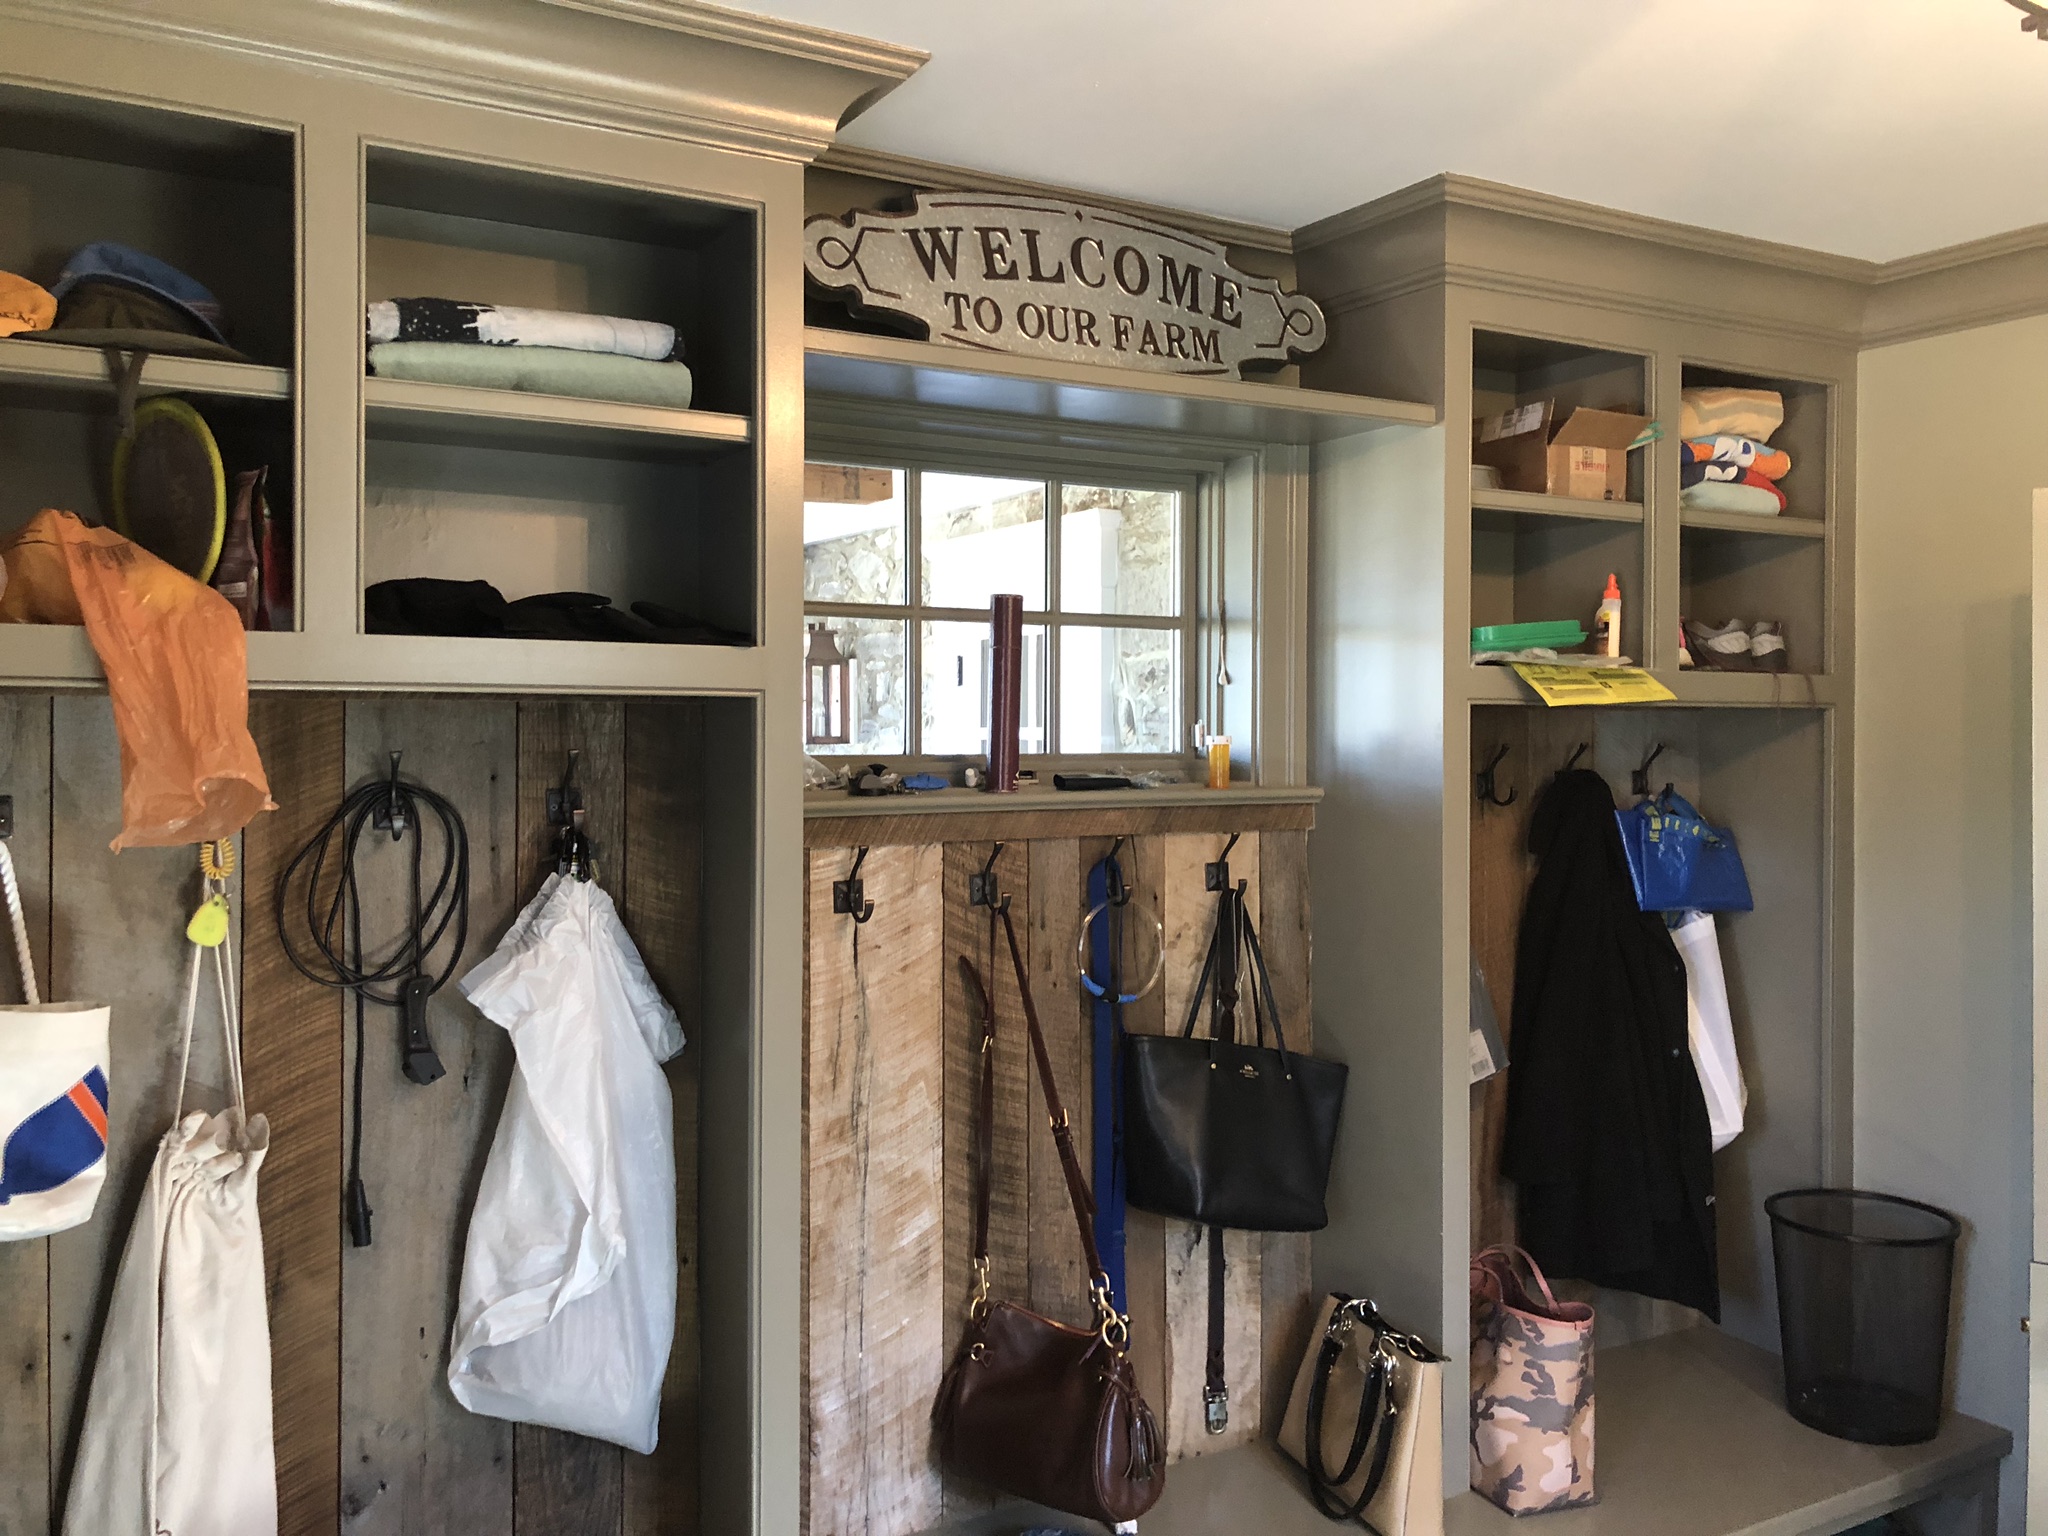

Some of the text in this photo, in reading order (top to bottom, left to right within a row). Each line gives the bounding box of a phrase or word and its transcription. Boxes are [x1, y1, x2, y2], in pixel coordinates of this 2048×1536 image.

[901, 226, 1243, 329] WELCOME
[944, 291, 1224, 365] TO OUR FARM
